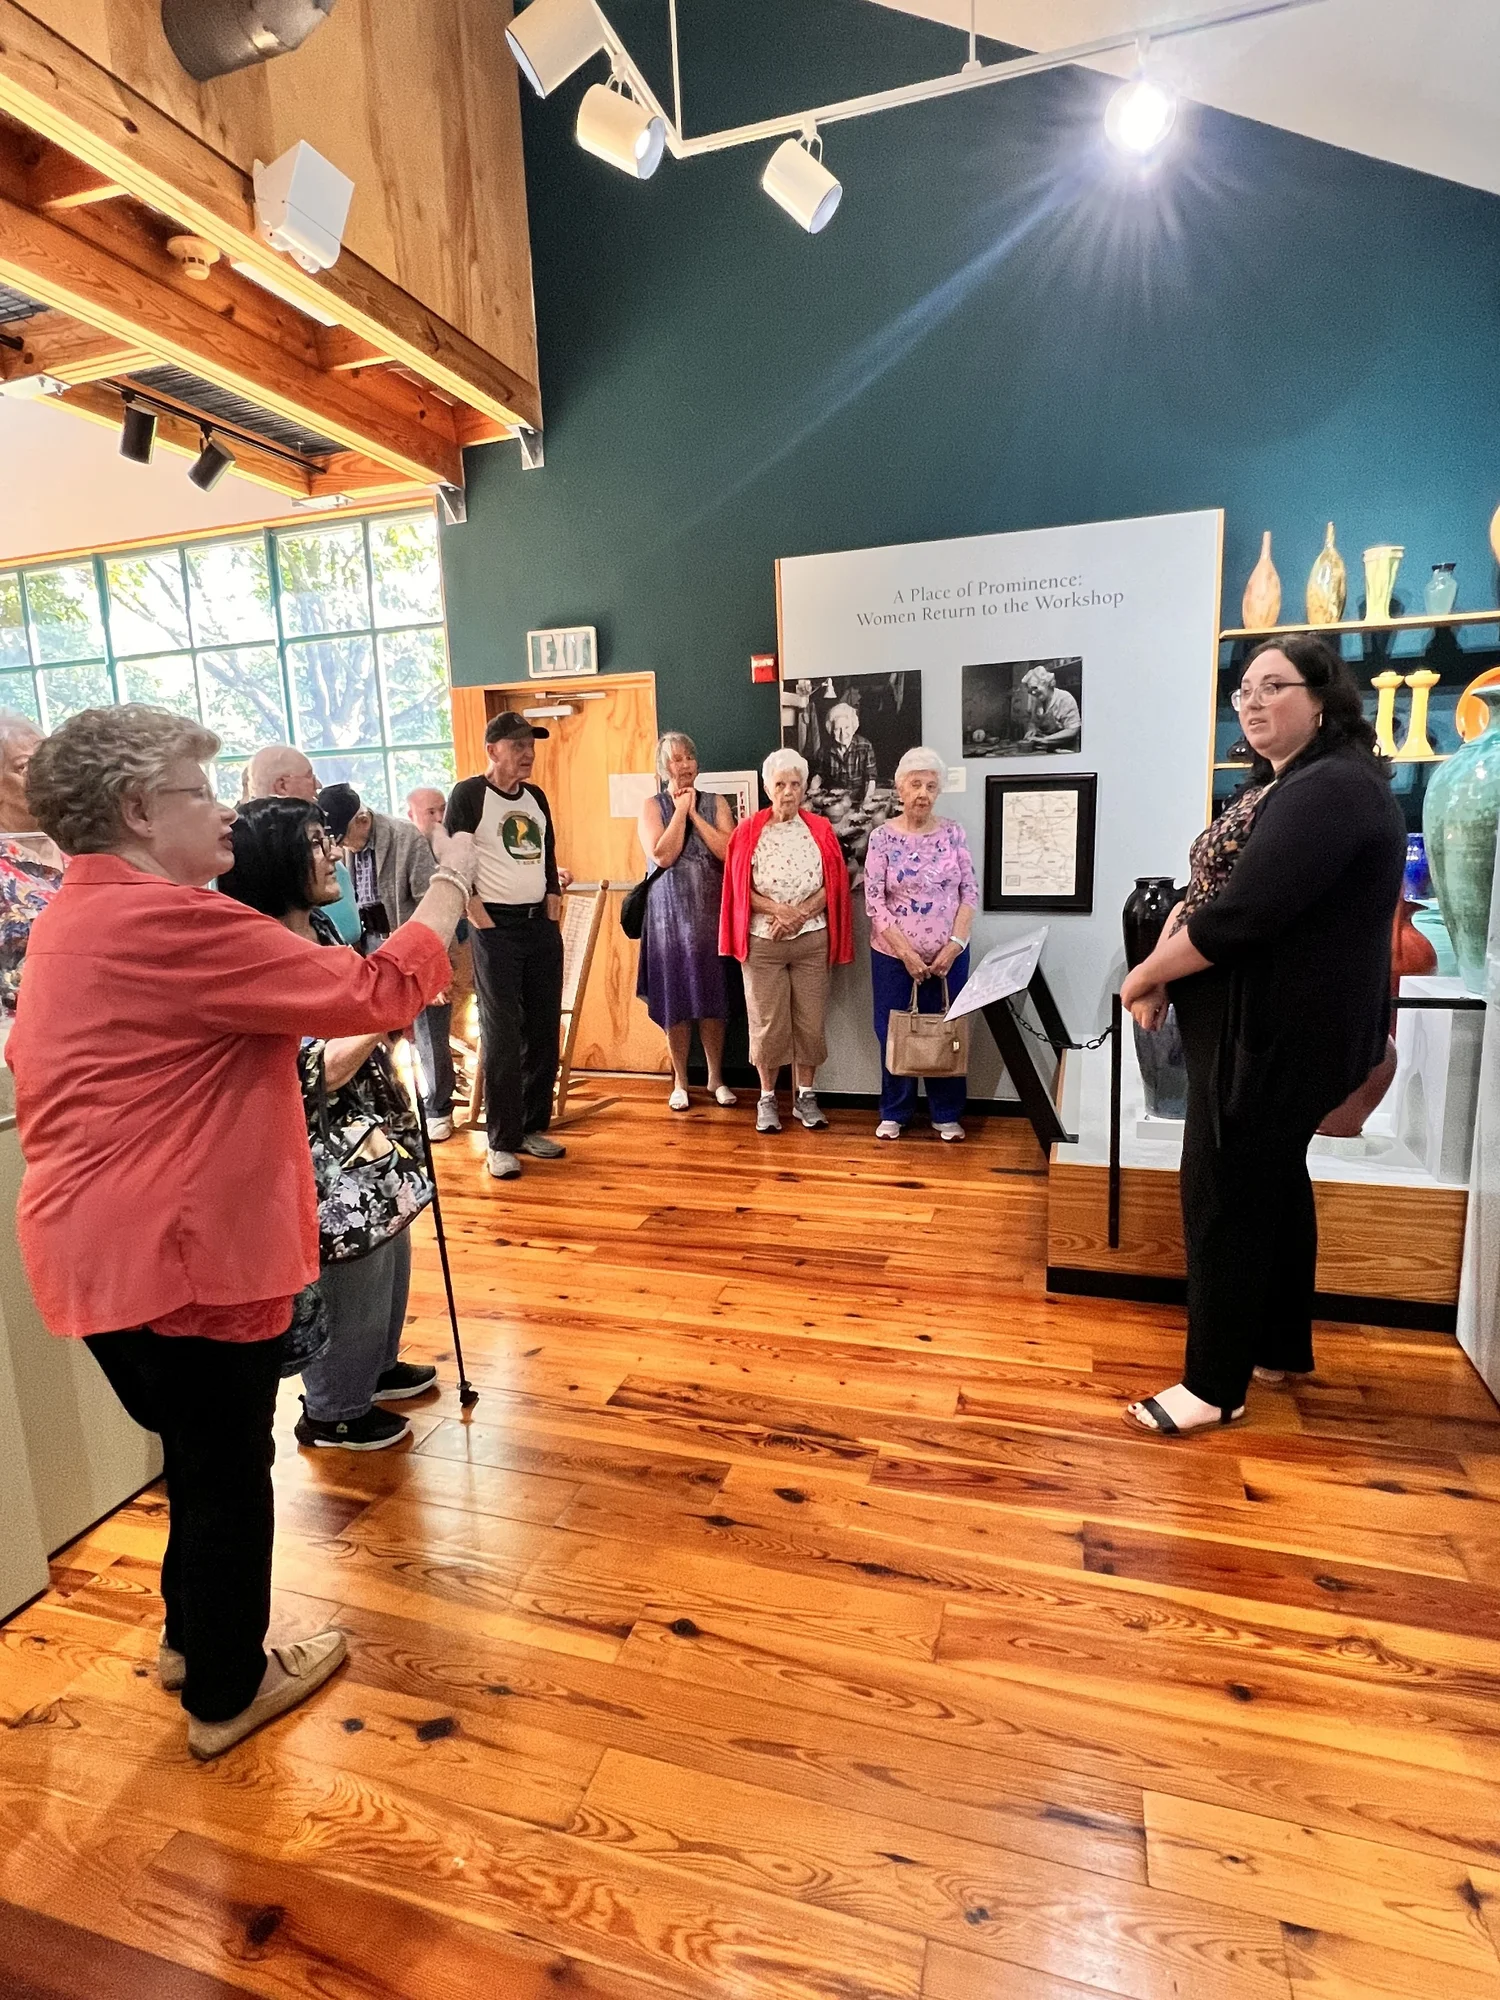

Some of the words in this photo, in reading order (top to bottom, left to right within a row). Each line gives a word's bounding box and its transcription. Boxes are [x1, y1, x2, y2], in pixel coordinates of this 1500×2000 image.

[893, 590, 905, 604] A
[910, 587, 951, 603] Place
[956, 580, 974, 598] of
[978, 574, 1083, 596] Prominence:
[856, 611, 917, 627] Women
[922, 605, 976, 621] Return
[981, 602, 998, 616] to
[1003, 598, 1030, 614] the
[1034, 590, 1125, 609] Workshop
[539, 632, 586, 671] EXIT
